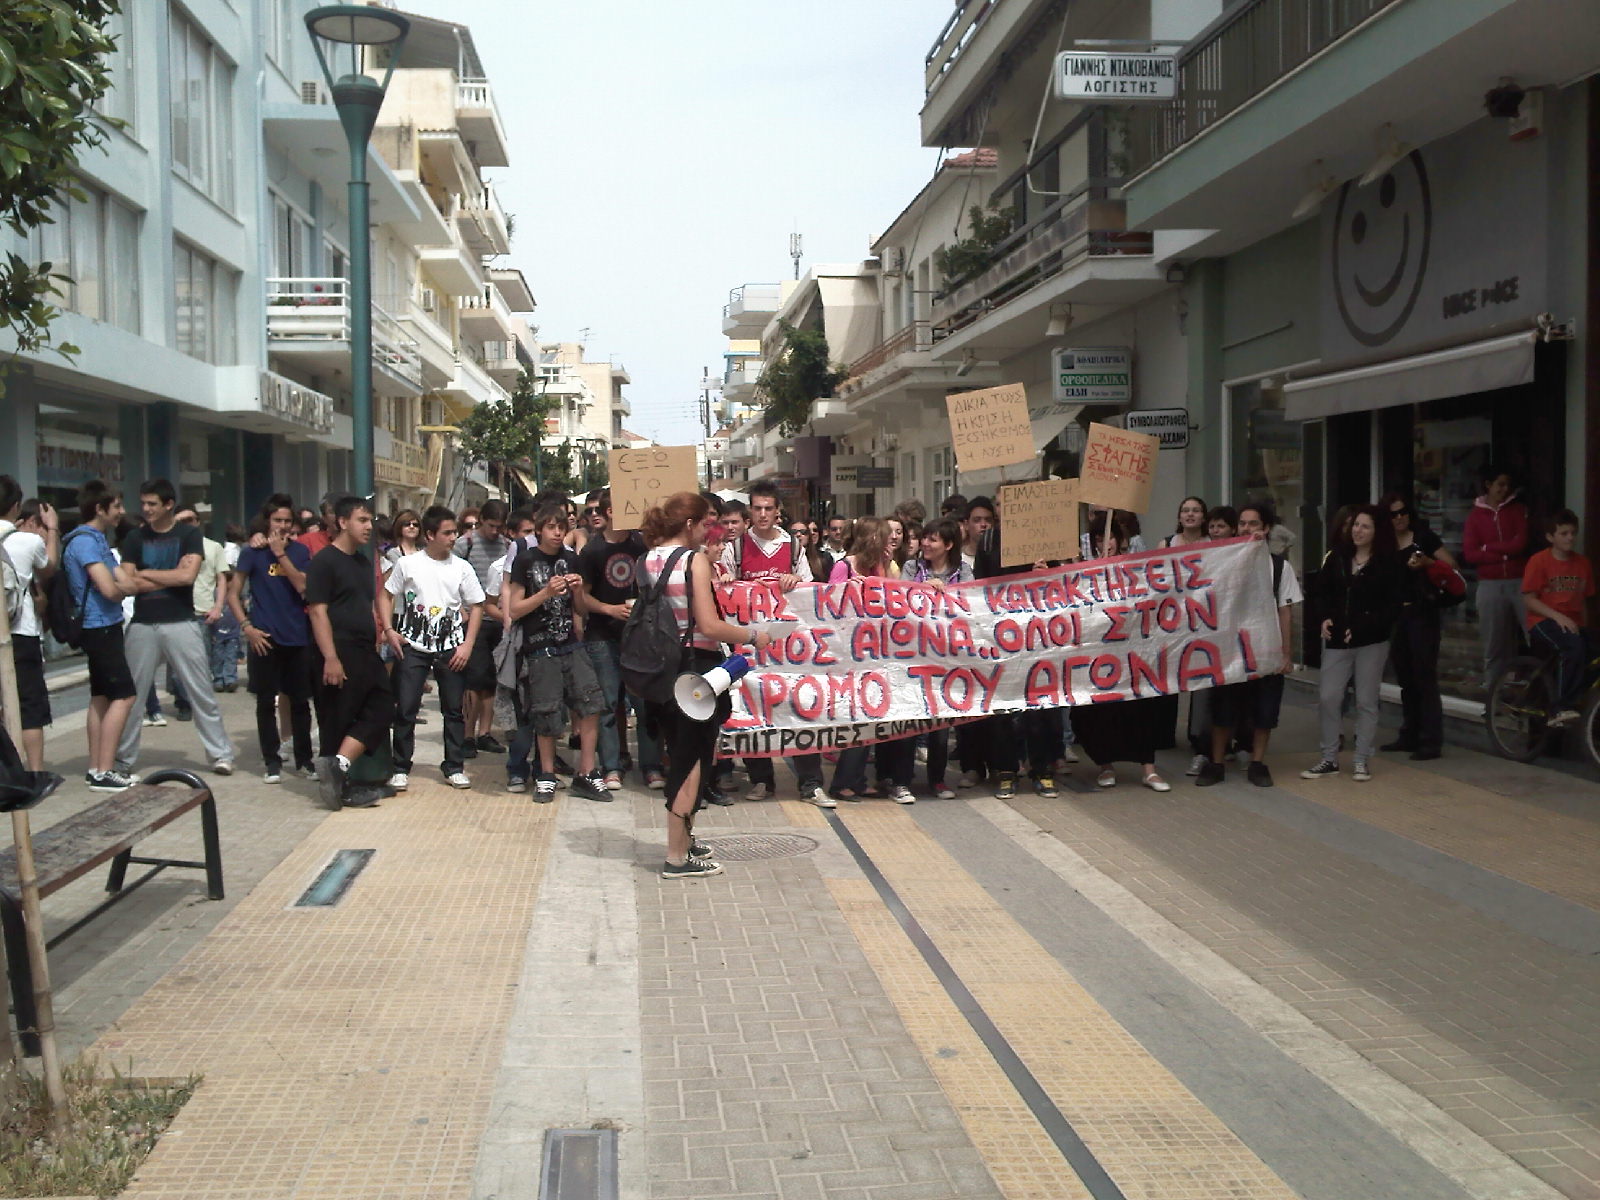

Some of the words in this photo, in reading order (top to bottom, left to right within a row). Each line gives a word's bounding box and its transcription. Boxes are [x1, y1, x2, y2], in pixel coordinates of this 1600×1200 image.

[1064, 58, 1107, 76] ΓΙΑΝΝΗΣ
[1110, 59, 1173, 77] ΝΤΑΚΟΒΑΝΟΣ
[1084, 80, 1157, 93] ΛΟΓΙΣΤΗΣ
[1061, 375, 1127, 385] ΟΡΘΟΠΕΔΙΚΑ
[1065, 388, 1088, 397] ΕΙΔΗ
[1088, 442, 1151, 475] ΣΦΑΓΗΣ
[714, 583, 799, 625] ΜΑΣ
[814, 576, 972, 622] ΚΛΕΒΟΥΝ
[983, 553, 1215, 615] ΚΑΤΑΚΤΗΣΕΙΣ
[1102, 590, 1218, 644] ΣΤΟΝ
[721, 670, 892, 732] ΔΡΟΜΟ
[907, 664, 1005, 716] ΤΟΥ
[719, 722, 870, 755] ΕΠΙΤΡΟΠΕΣ
